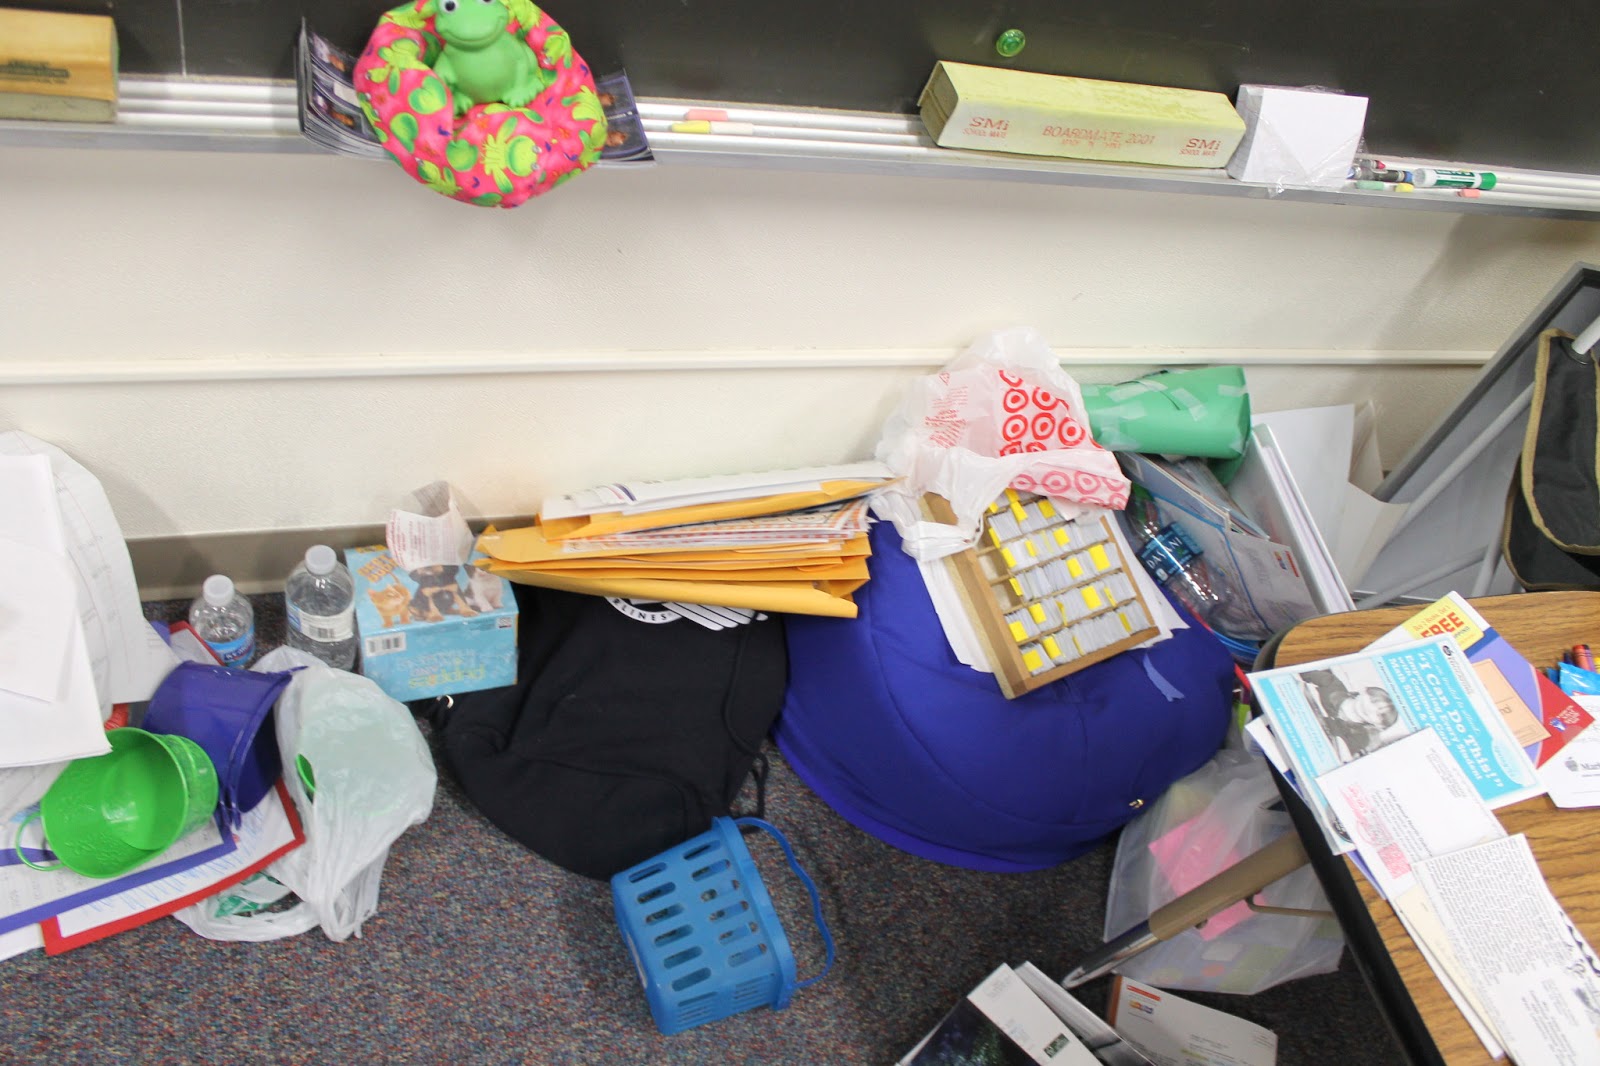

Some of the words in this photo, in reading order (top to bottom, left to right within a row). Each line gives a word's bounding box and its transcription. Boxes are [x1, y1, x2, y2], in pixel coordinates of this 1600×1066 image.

[968, 116, 1010, 132] SMi
[1185, 137, 1222, 151] SMi
[1146, 537, 1182, 569] DASANI
[1420, 611, 1464, 638] FREE
[1386, 658, 1408, 682] Math
[1401, 684, 1423, 710] Skills
[1396, 656, 1413, 676] with
[1406, 678, 1439, 720] Common
[1433, 723, 1453, 745] Core
[1424, 673, 1452, 705] Can
[1446, 709, 1468, 732] Do
[1403, 653, 1443, 714] Empowering
[1438, 713, 1460, 743] Every
[1455, 743, 1484, 779] Student
